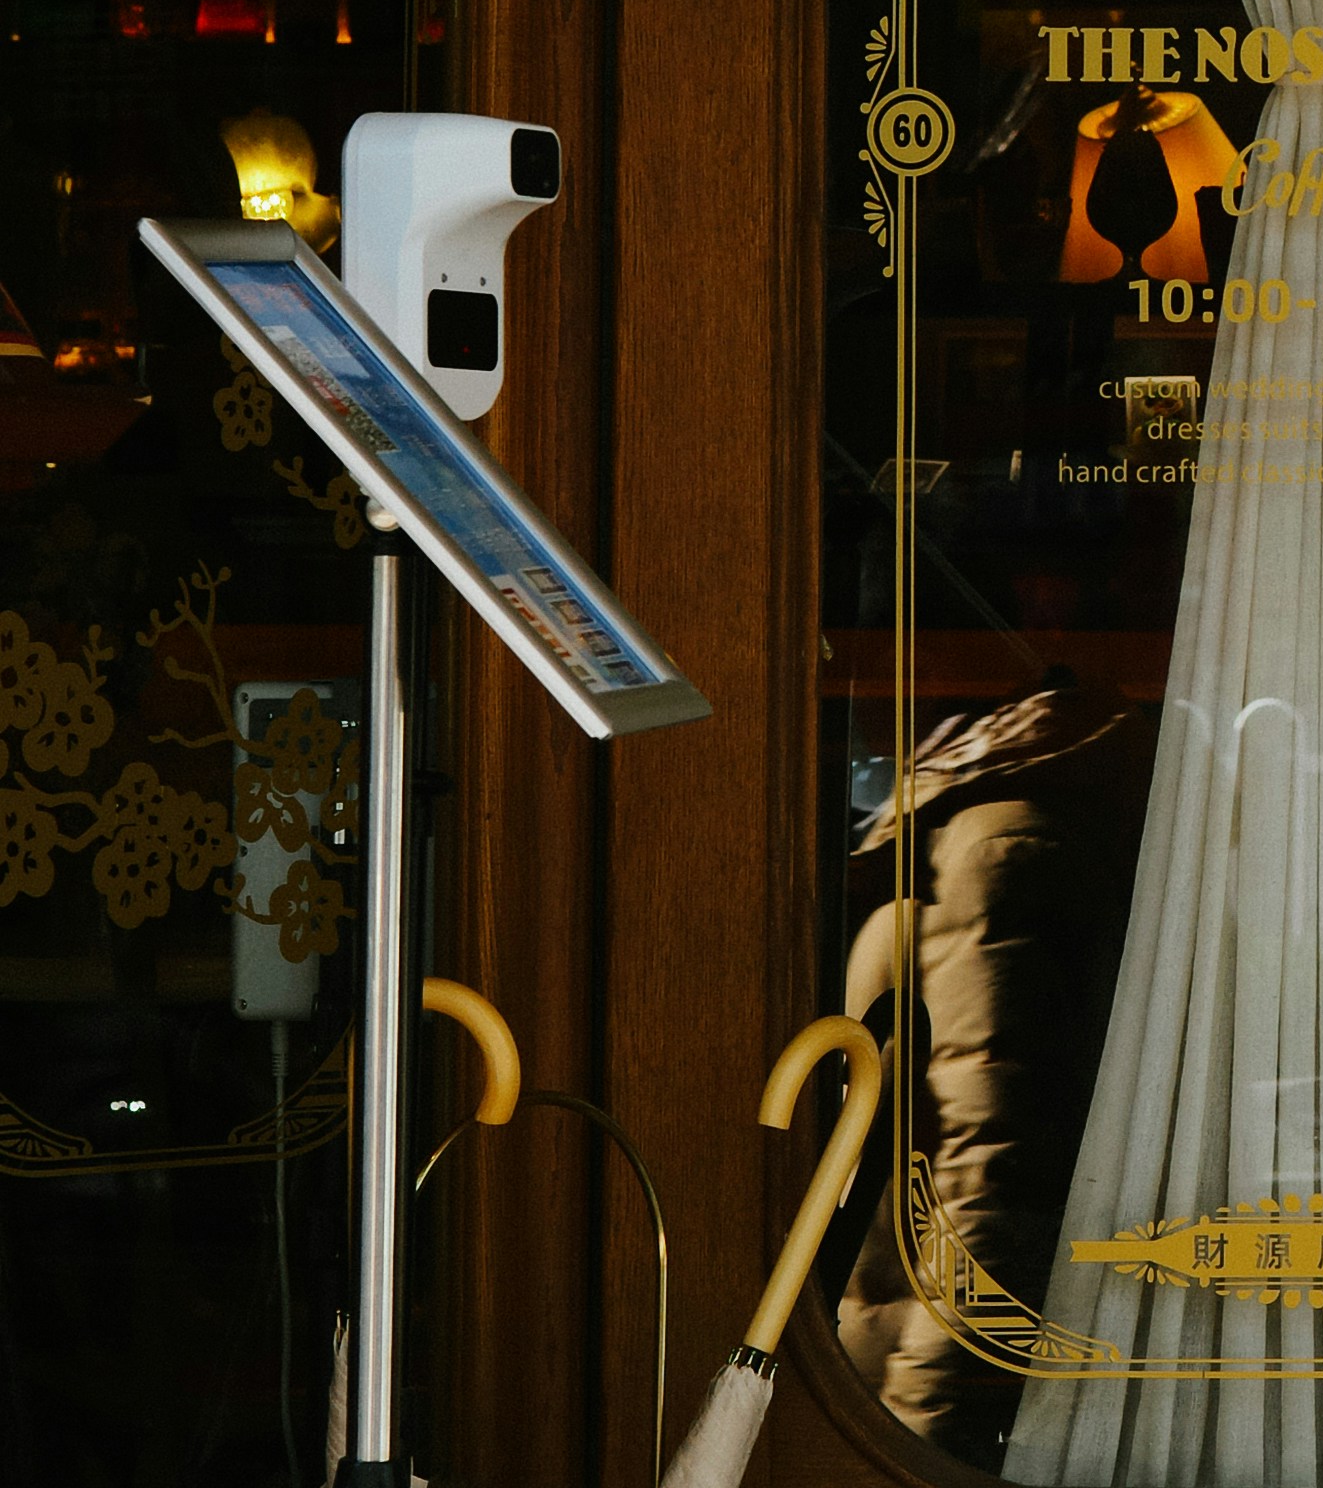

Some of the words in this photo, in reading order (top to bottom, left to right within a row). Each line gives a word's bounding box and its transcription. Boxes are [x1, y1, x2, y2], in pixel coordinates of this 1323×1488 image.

[1038, 25, 1182, 85] THE
[893, 113, 933, 148] 60
[1098, 379, 1202, 400] custom
[1147, 416, 1250, 440] dresses
[1258, 417, 1323, 440] suits
[1057, 458, 1129, 484] hand
[1135, 458, 1235, 485] crafted
